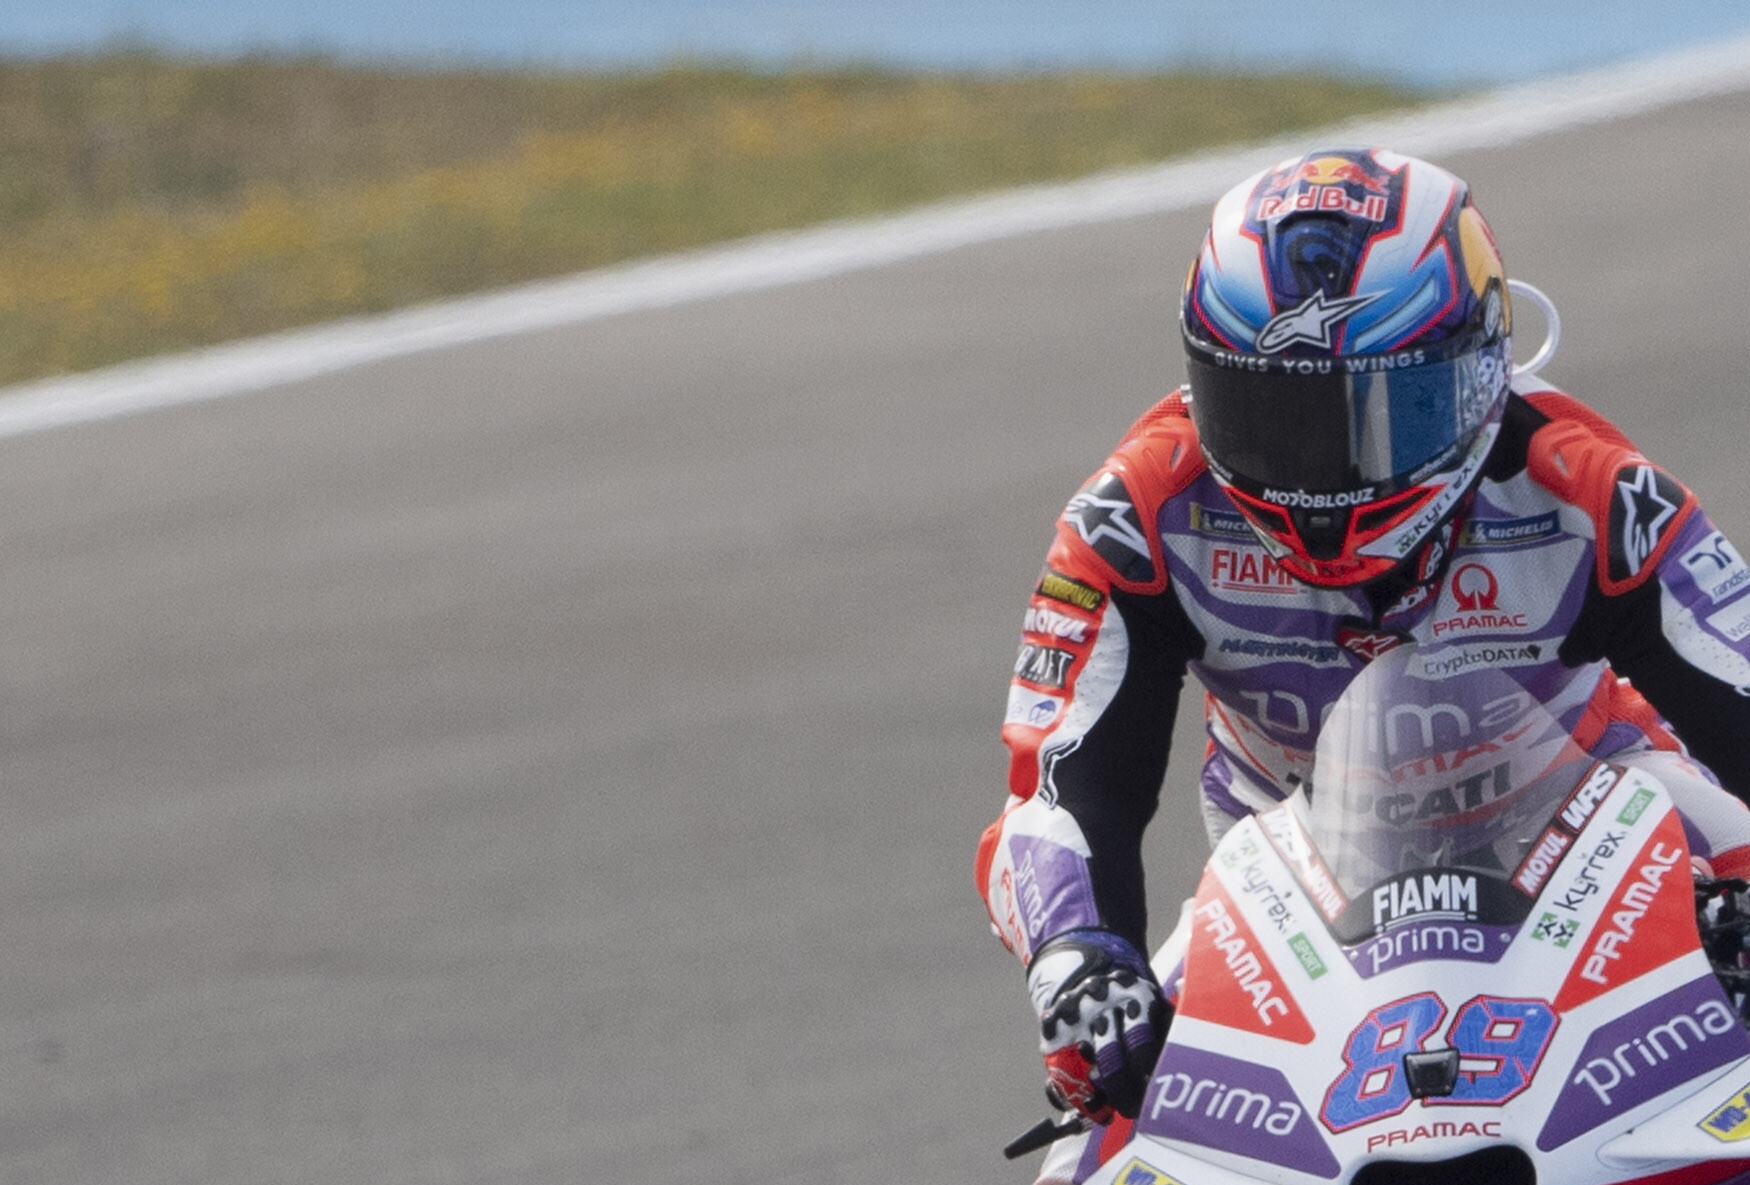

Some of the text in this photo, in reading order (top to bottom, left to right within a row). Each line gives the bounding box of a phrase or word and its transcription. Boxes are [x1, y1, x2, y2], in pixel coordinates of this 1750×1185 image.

[1319, 187, 1388, 222] Bull
[1215, 350, 1426, 375] GIVES YOU WINGS
[1263, 487, 1375, 508] MOTOBLOUZ
[1024, 608, 1089, 643] MOTUL
[1433, 613, 1528, 636] PRAMAC
[1517, 832, 1569, 894] MOTUL
[1553, 832, 1626, 911] kyrrex
[1373, 874, 1478, 926] FIAMM
[1580, 842, 1683, 984] PRAMAC
[1195, 898, 1290, 1027] PRAMAC
[1367, 926, 1485, 973] prima
[1318, 990, 1562, 1135] 89
[1574, 999, 1736, 1106] prima
[1151, 1073, 1301, 1136] prima
[1367, 1121, 1502, 1154] PRAMAC
